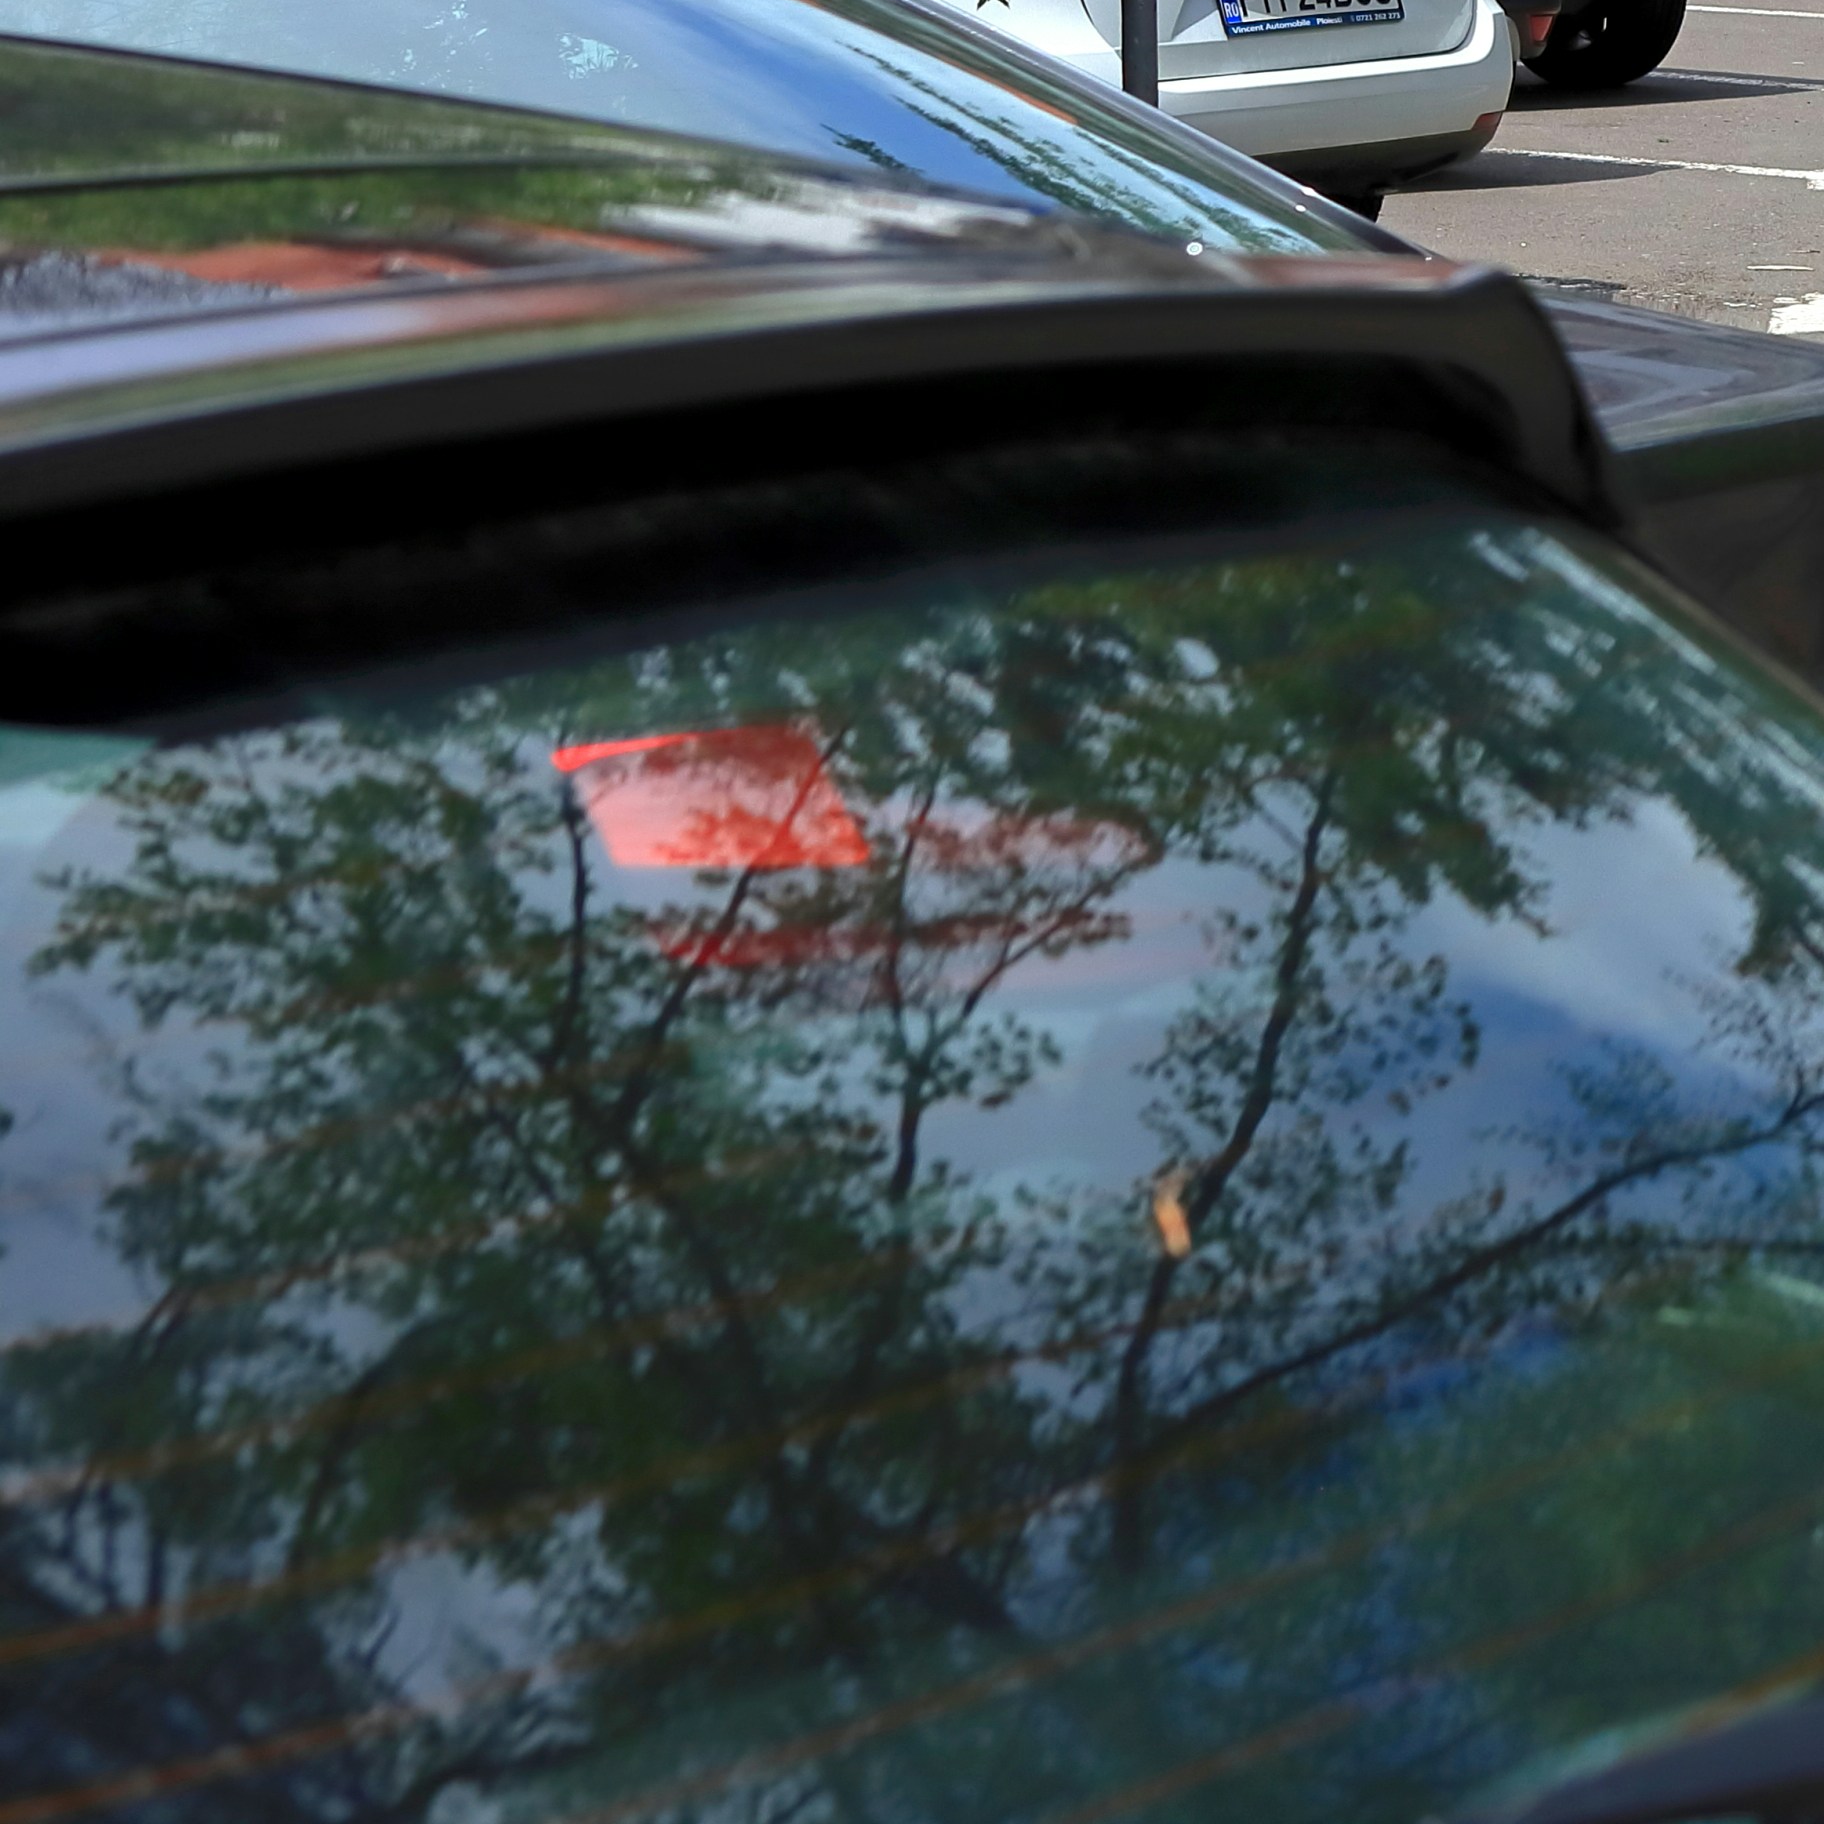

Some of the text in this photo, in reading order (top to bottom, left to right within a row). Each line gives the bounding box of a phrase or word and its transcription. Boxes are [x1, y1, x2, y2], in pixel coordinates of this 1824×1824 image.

[1224, 2, 1240, 18] RO
[1231, 24, 1264, 34] Vincent
[1265, 19, 1311, 31] Automobile
